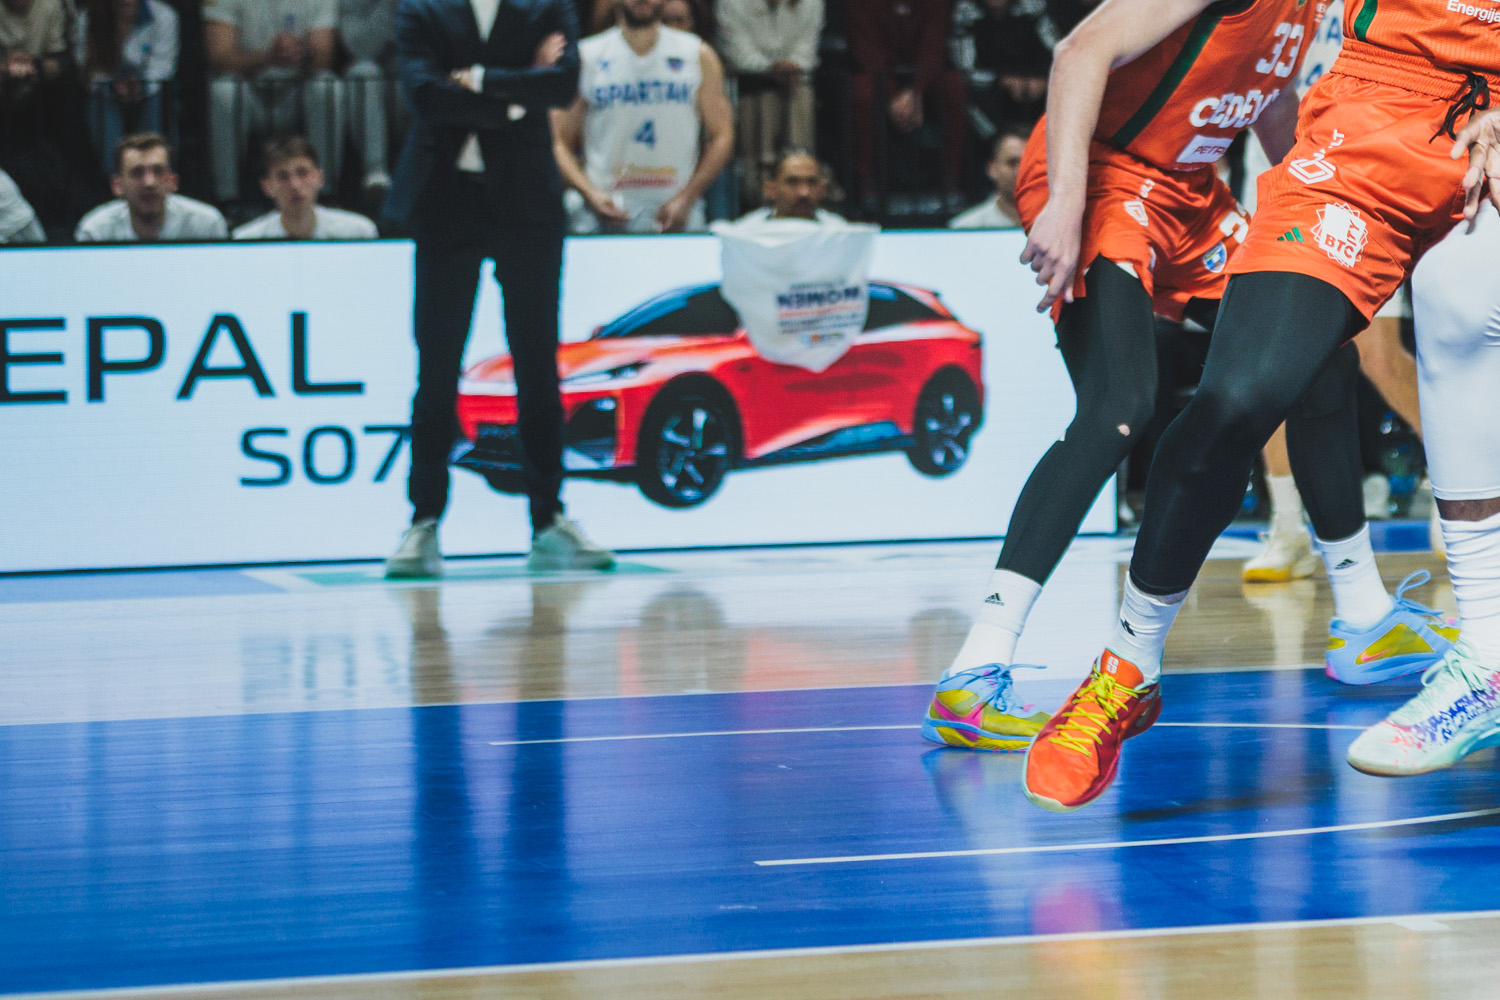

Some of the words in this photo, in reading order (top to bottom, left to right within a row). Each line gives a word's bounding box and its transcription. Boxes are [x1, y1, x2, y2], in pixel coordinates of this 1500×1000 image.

[1256, 22, 1305, 78] 33
[634, 119, 656, 149] 4
[1325, 234, 1354, 259] BTC
[0, 312, 365, 405] EPAL
[240, 425, 412, 487] S07
